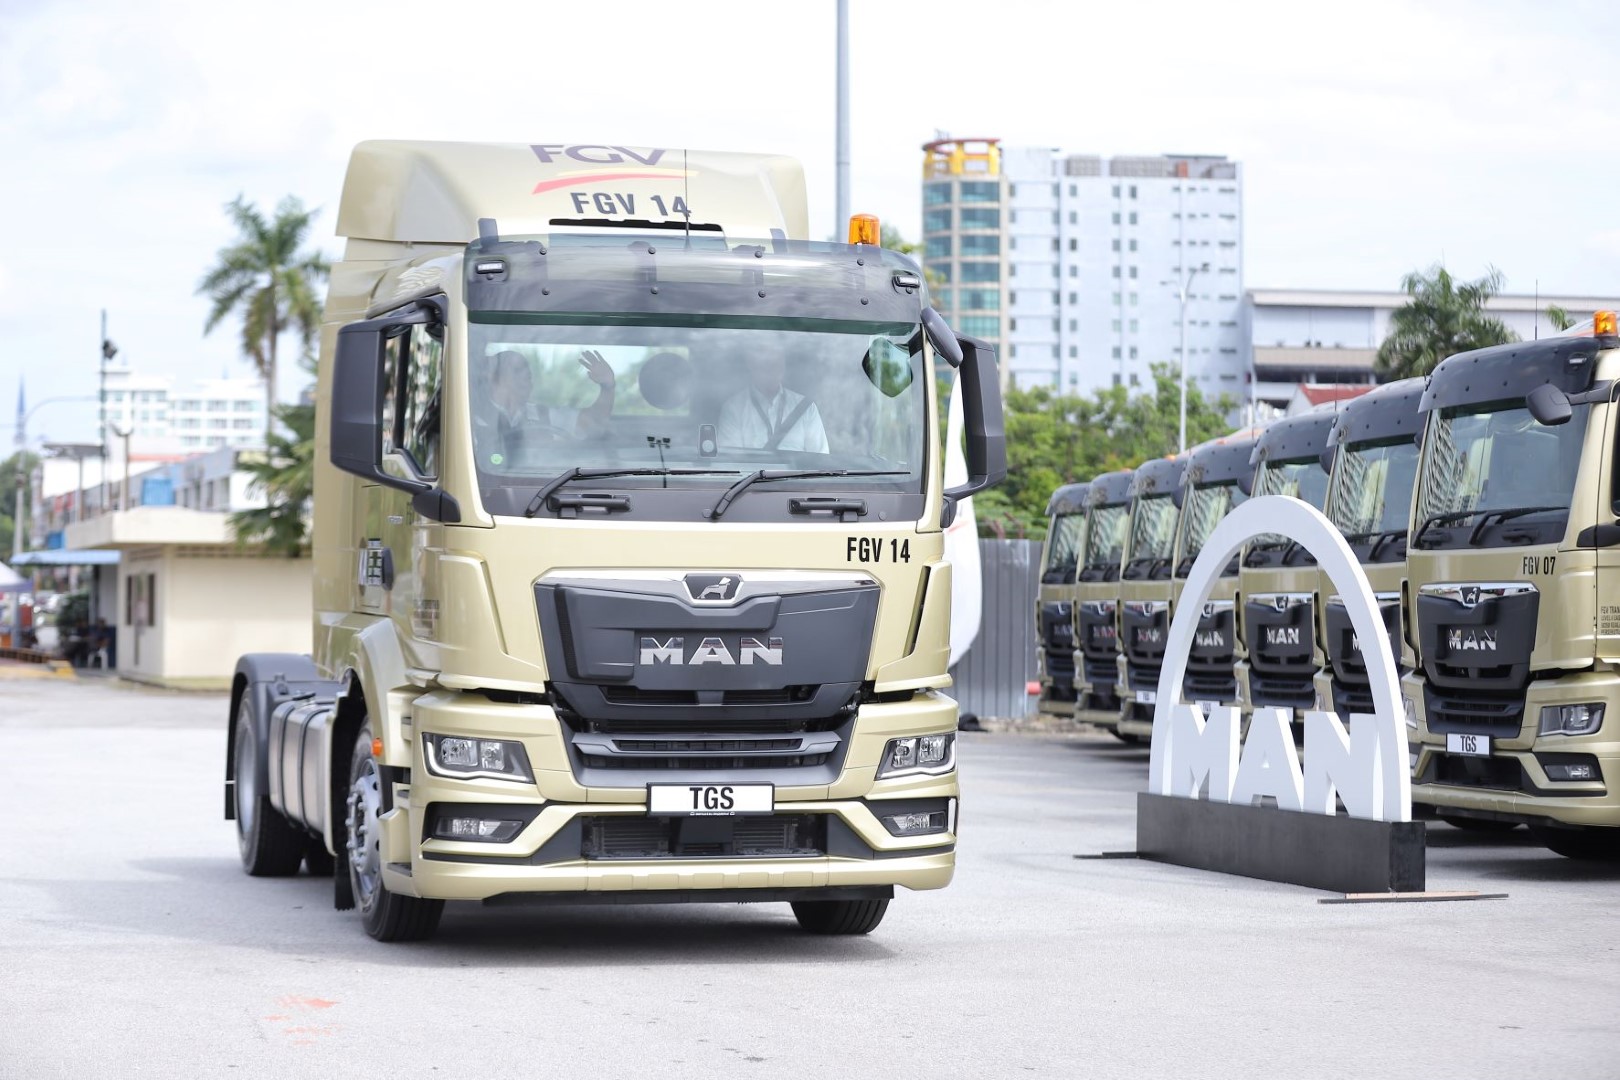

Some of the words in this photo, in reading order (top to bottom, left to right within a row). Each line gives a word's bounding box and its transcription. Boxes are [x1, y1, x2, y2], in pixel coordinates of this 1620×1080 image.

[530, 144, 667, 166] FGV
[570, 192, 636, 215] FGV
[650, 194, 692, 218] 14
[846, 536, 883, 563] FGV
[890, 538, 911, 563] 14
[1522, 556, 1541, 576] FGV
[1543, 556, 1556, 575] 07
[1195, 630, 1224, 647] MAN
[1266, 627, 1300, 645] MAN
[1448, 629, 1498, 651] MAN
[639, 637, 783, 666] MAN
[1460, 735, 1477, 753] TGS
[1168, 704, 1380, 821] MAN
[689, 787, 734, 810] TGS
